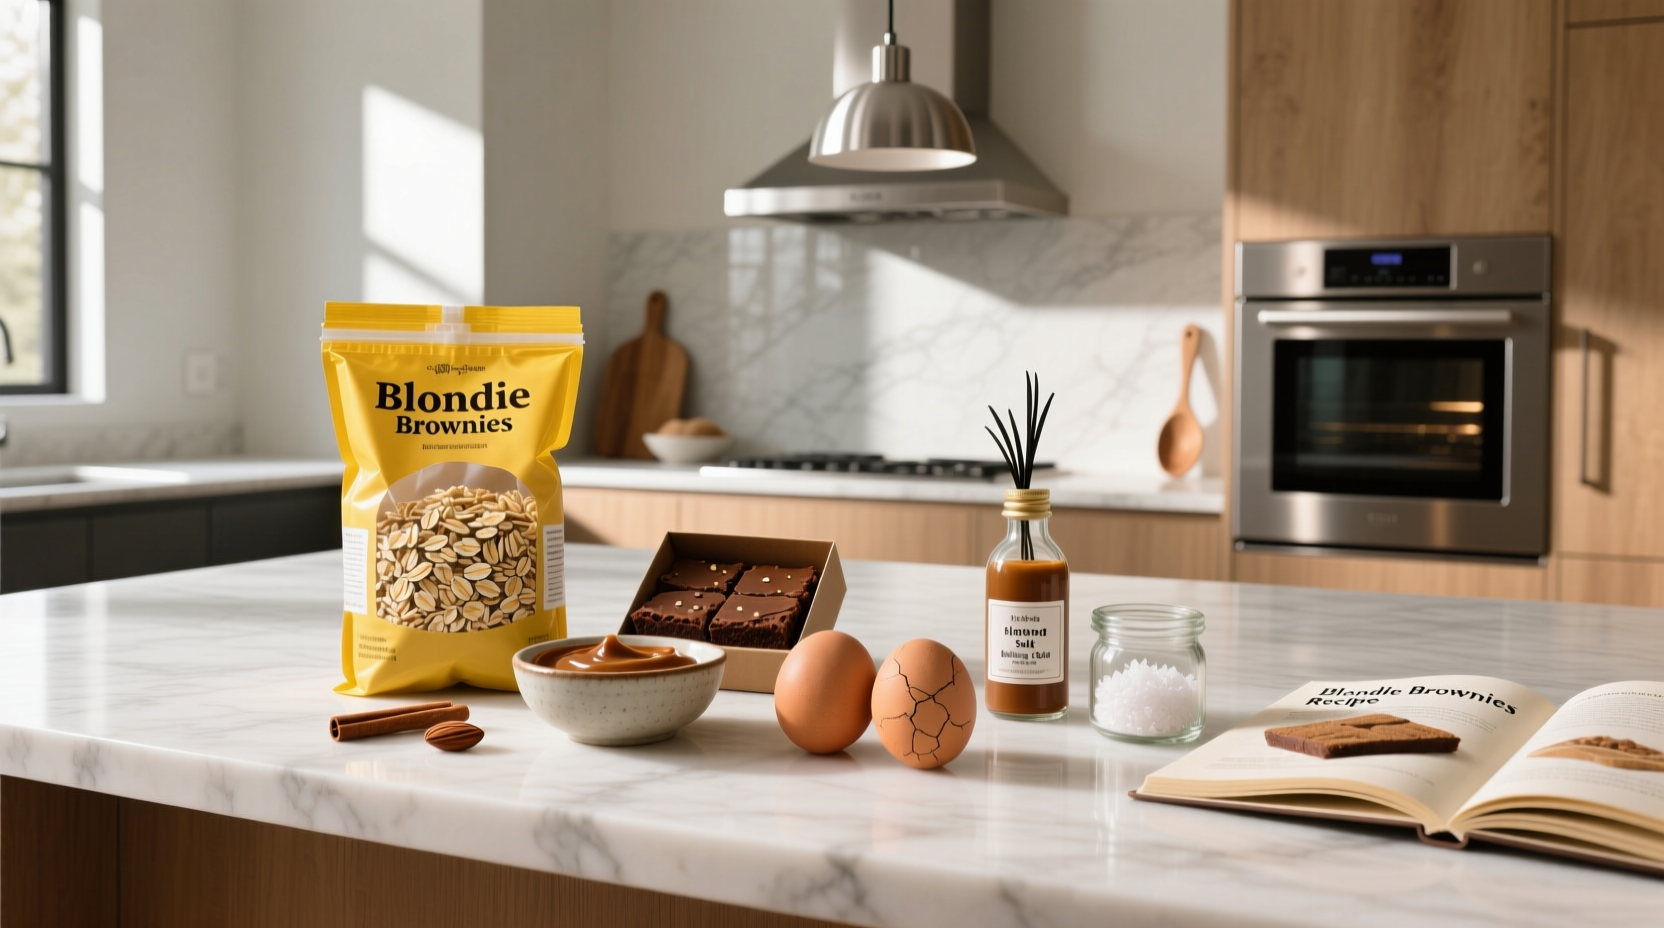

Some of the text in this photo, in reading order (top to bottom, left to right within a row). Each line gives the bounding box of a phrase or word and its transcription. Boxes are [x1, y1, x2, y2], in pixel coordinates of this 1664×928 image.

[375, 381, 530, 413] Blondie
[395, 414, 513, 435] Brownies
[1408, 685, 1518, 715] Brownies
